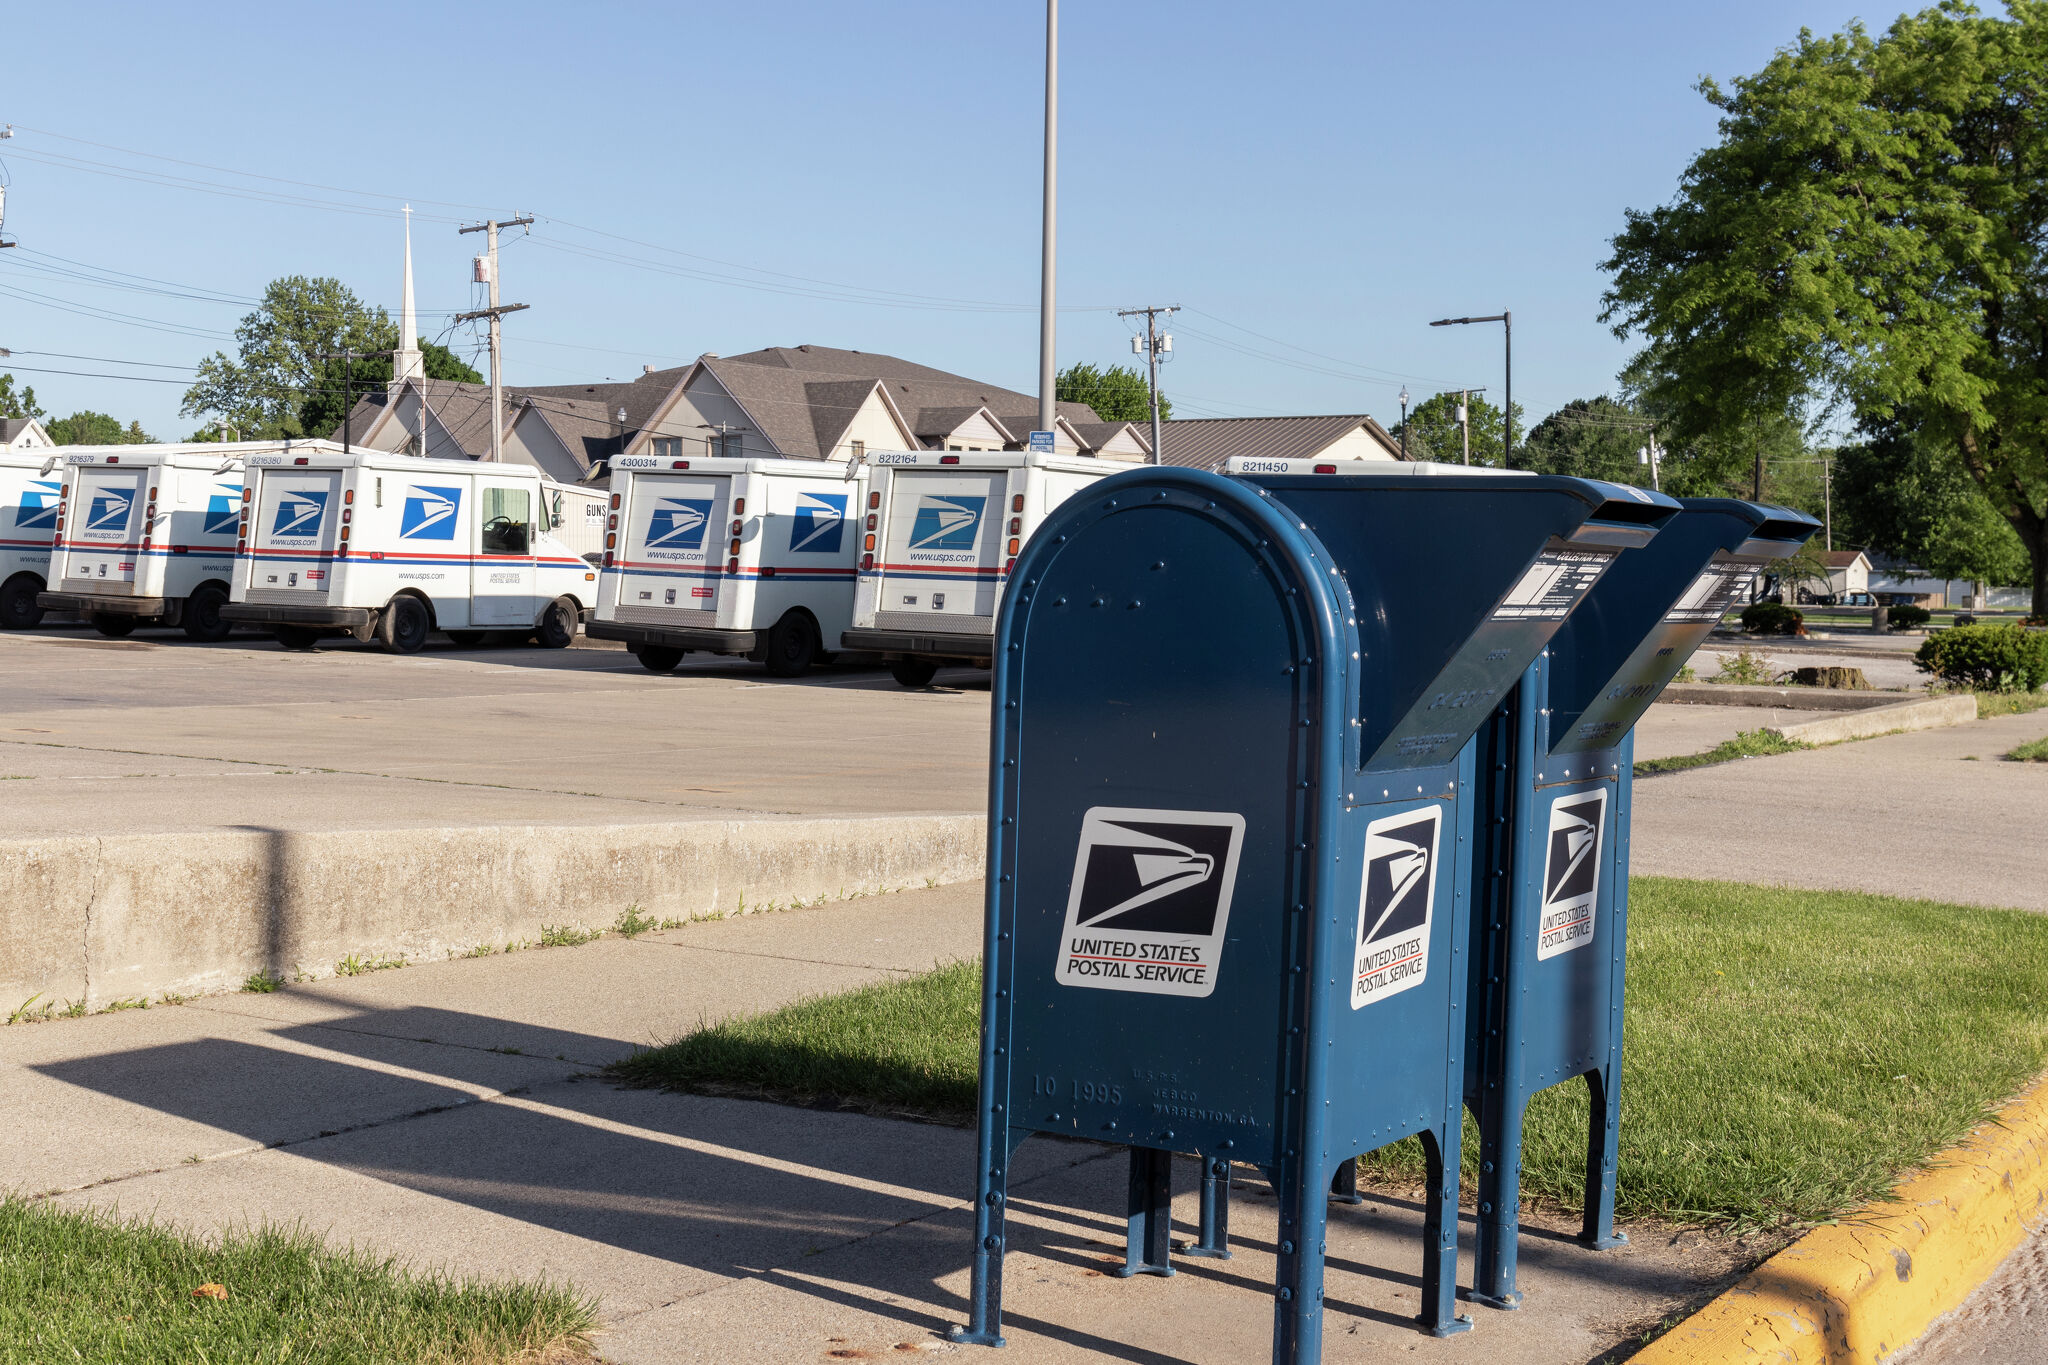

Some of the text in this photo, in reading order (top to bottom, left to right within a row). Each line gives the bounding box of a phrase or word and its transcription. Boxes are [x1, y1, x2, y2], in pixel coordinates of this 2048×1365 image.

[69, 455, 94, 463] 9216379
[251, 456, 281, 464] 9216380
[620, 458, 657, 467] 4300314
[879, 454, 917, 464] 8212164
[1242, 461, 1288, 472] 8211450
[586, 504, 606, 516] GUNS
[83, 531, 124, 540] www.usps.com
[270, 539, 317, 548] www.usps.com
[647, 551, 704, 562] www.usps.com
[910, 552, 975, 565] www.usps.com
[398, 572, 445, 581] www.usps.com
[1543, 903, 1589, 930] UNITED STATES
[1541, 921, 1591, 950] POSTAL SERVICE
[1071, 938, 1200, 962] UNITED STATES
[1359, 937, 1421, 974] UNITED STATES
[1067, 959, 1206, 984] POSTAL SERVICE
[1356, 957, 1423, 997] POSTAL SERVICE
[1032, 1073, 1122, 1106] 10 1995
